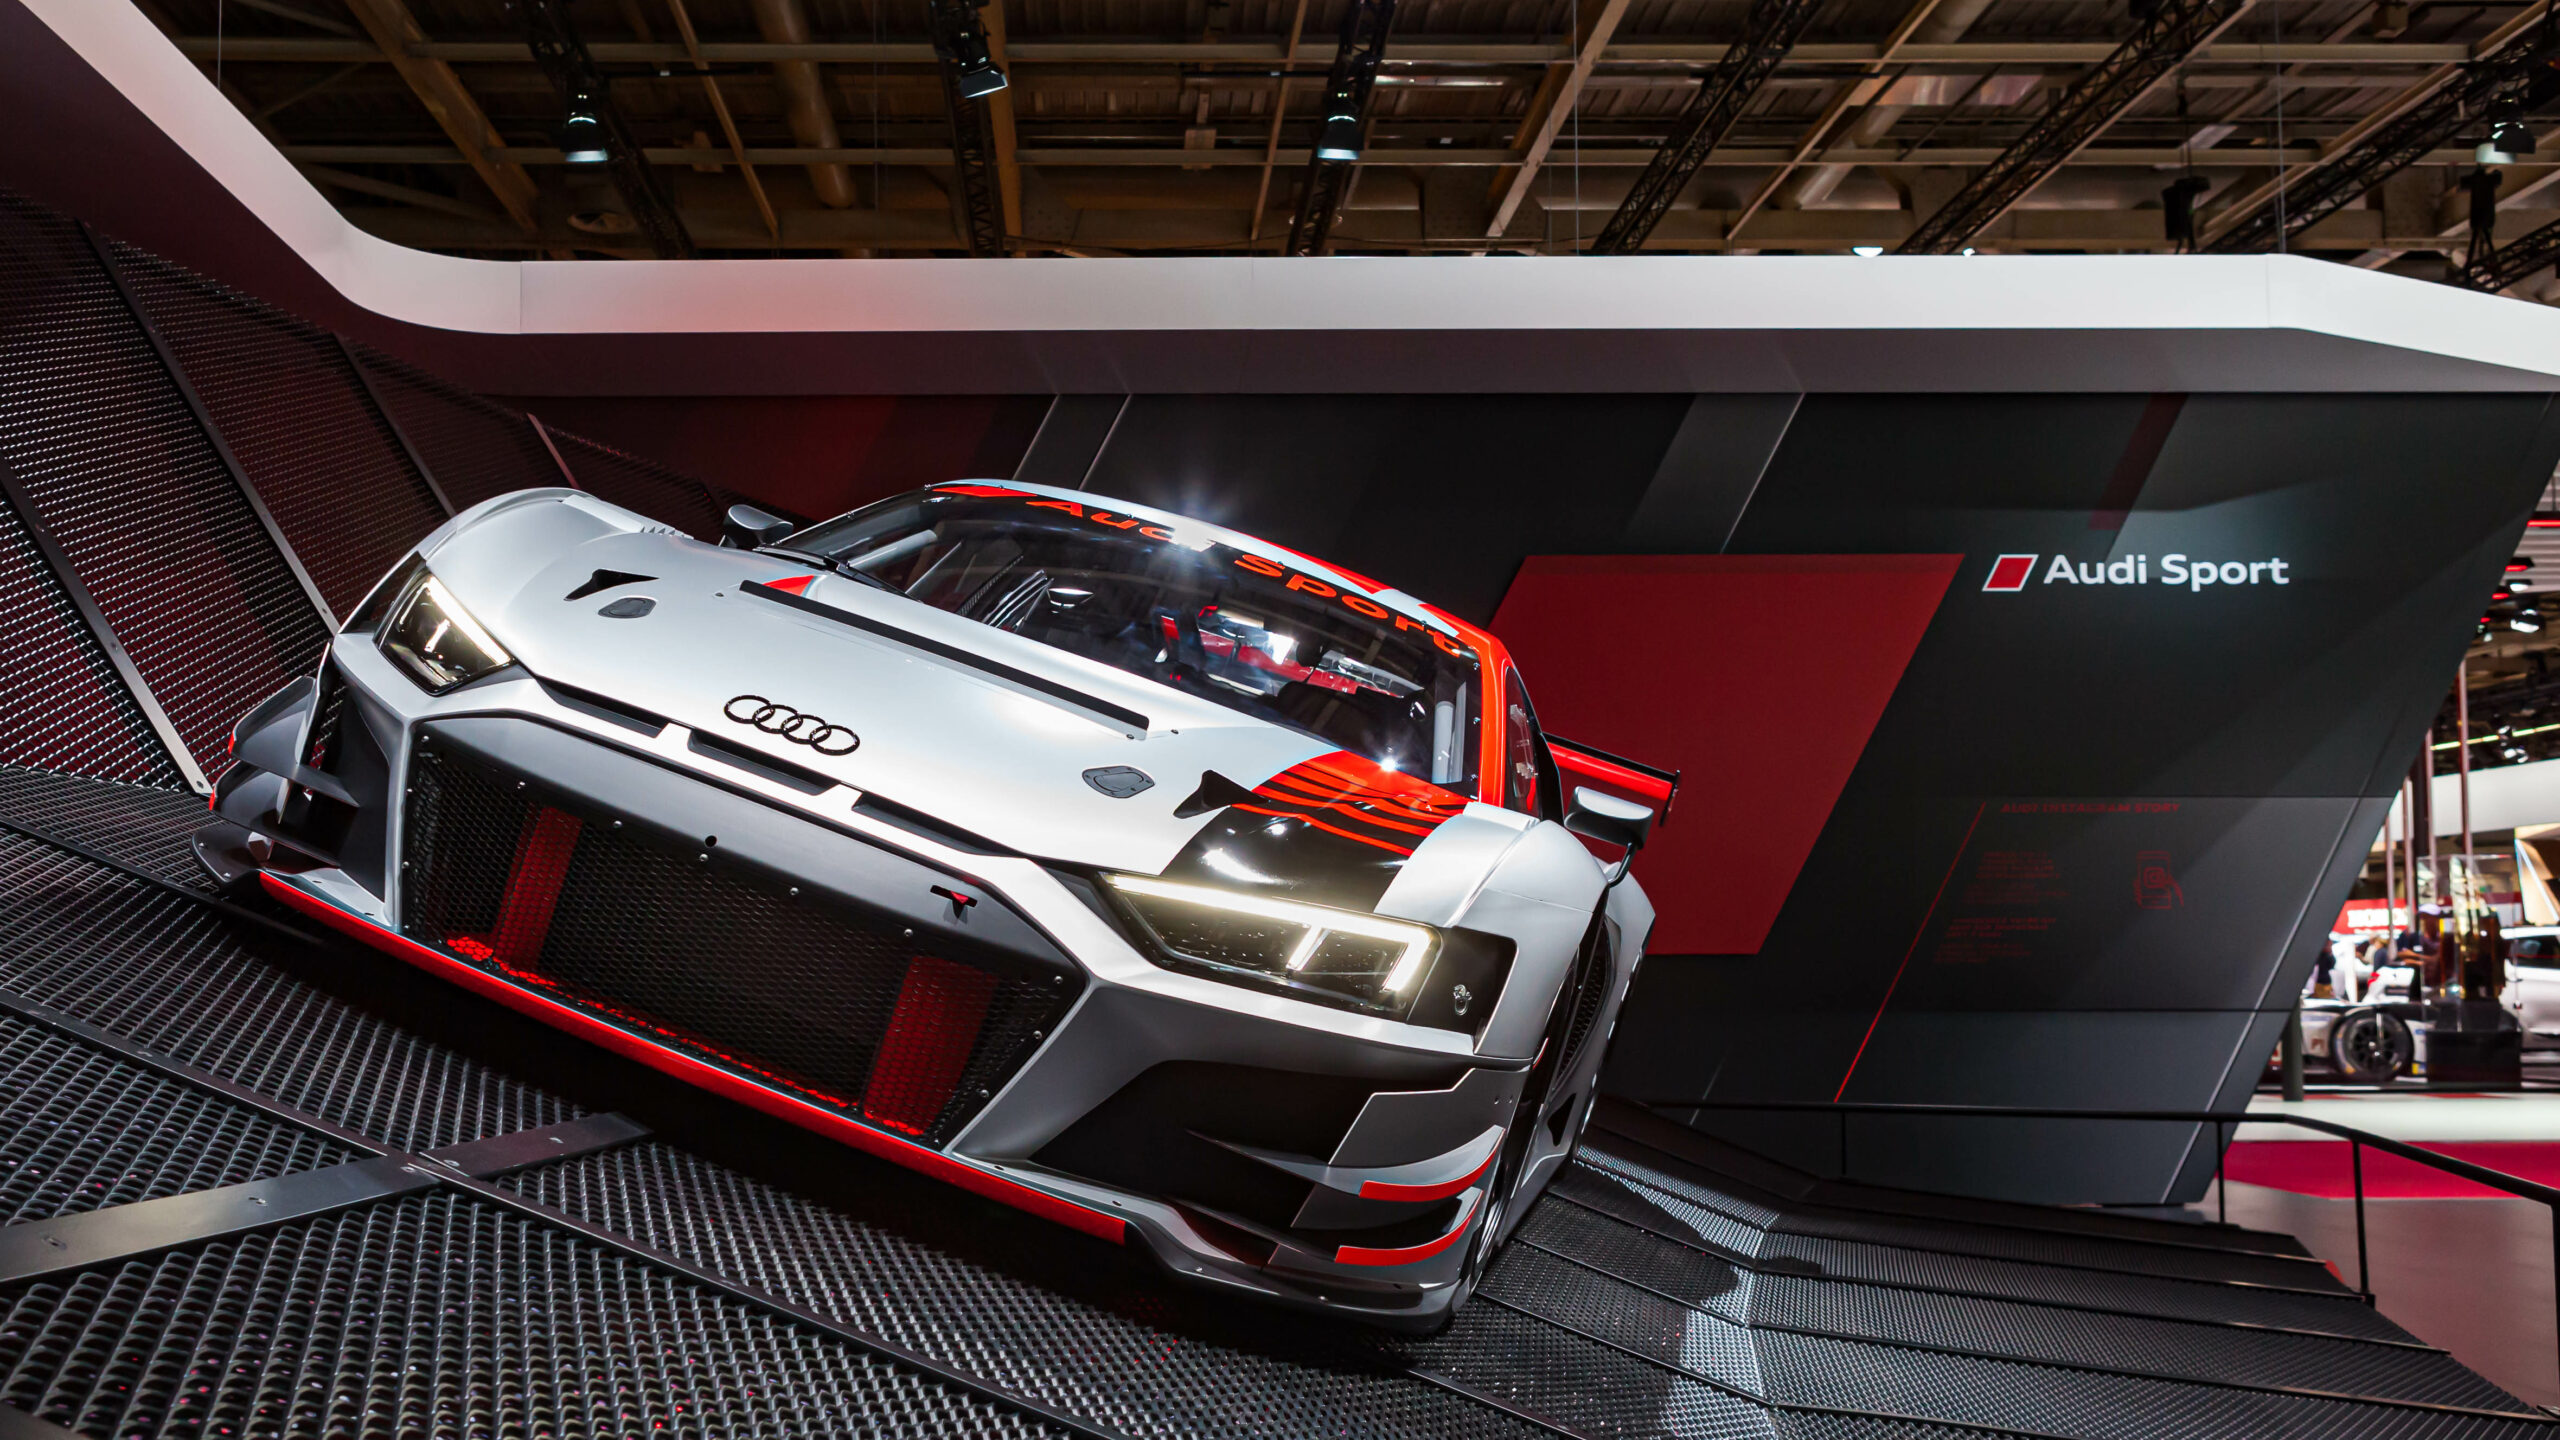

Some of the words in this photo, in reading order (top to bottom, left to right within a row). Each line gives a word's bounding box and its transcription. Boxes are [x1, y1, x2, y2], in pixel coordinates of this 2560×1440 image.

[1026, 501, 1215, 552] Aud
[1234, 554, 1460, 658] Sport
[2043, 554, 2147, 584] Audi
[2161, 554, 2290, 592] Sport
[2133, 802, 2182, 813] STORY
